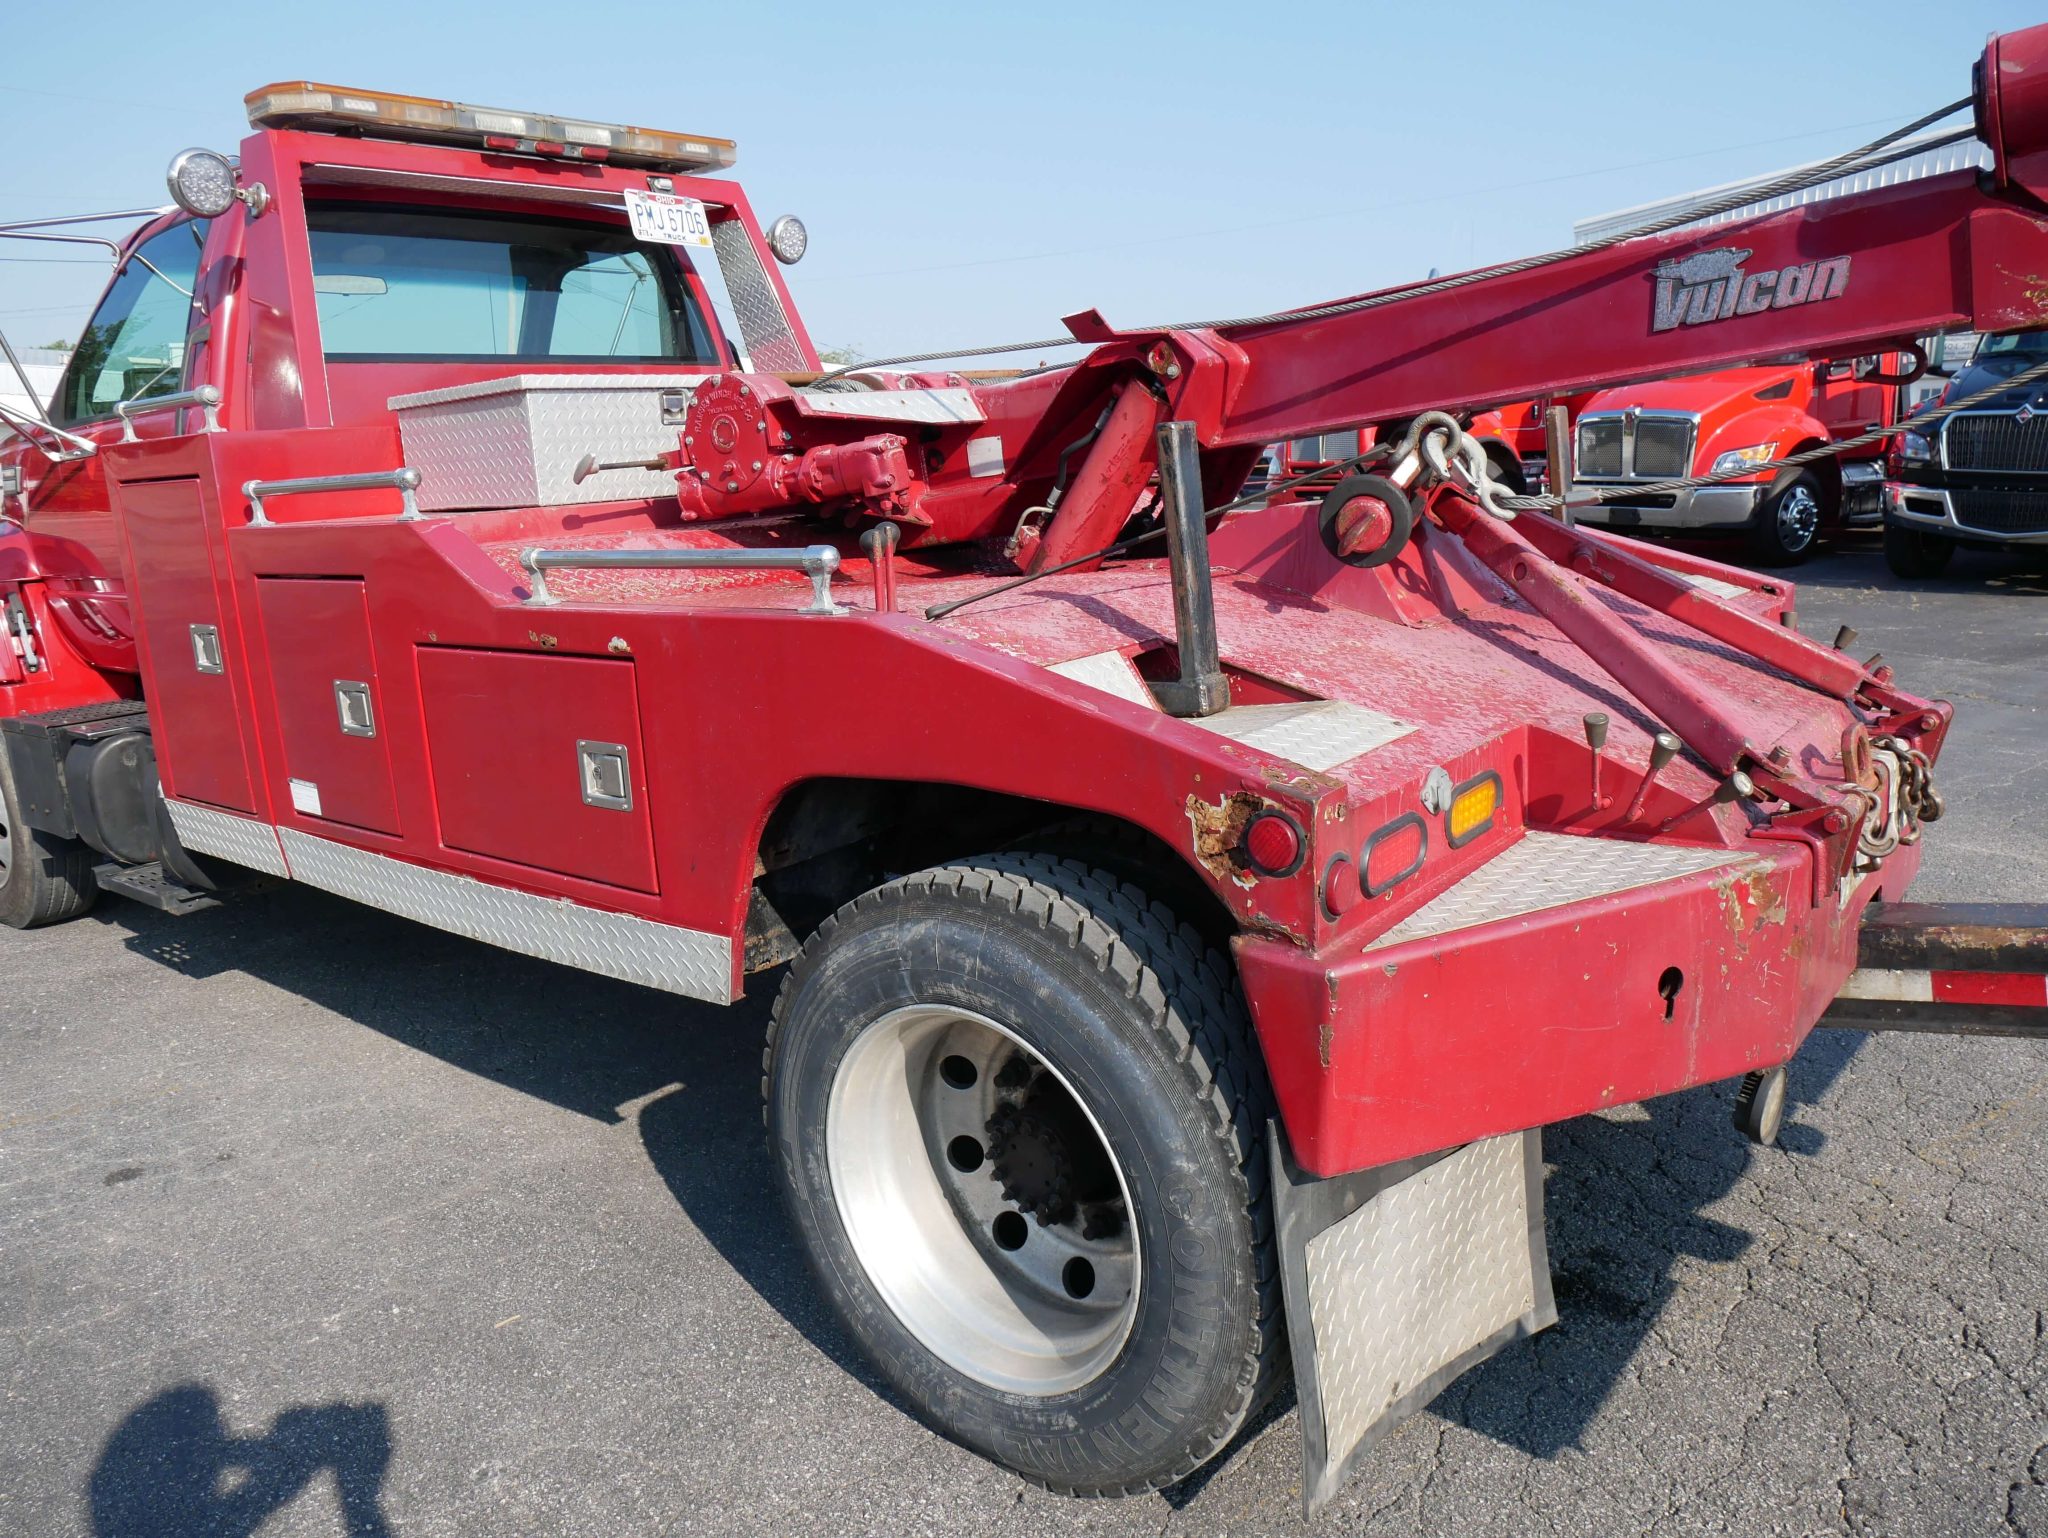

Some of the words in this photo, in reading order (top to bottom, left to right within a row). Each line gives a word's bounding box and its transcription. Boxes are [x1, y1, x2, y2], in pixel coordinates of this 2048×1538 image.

[655, 195, 675, 205] OHIO
[635, 203, 665, 230] PMJ
[667, 208, 705, 235] 6706
[663, 233, 687, 241] TRUCK
[1002, 1172, 1221, 1474] CONTINENTAL
